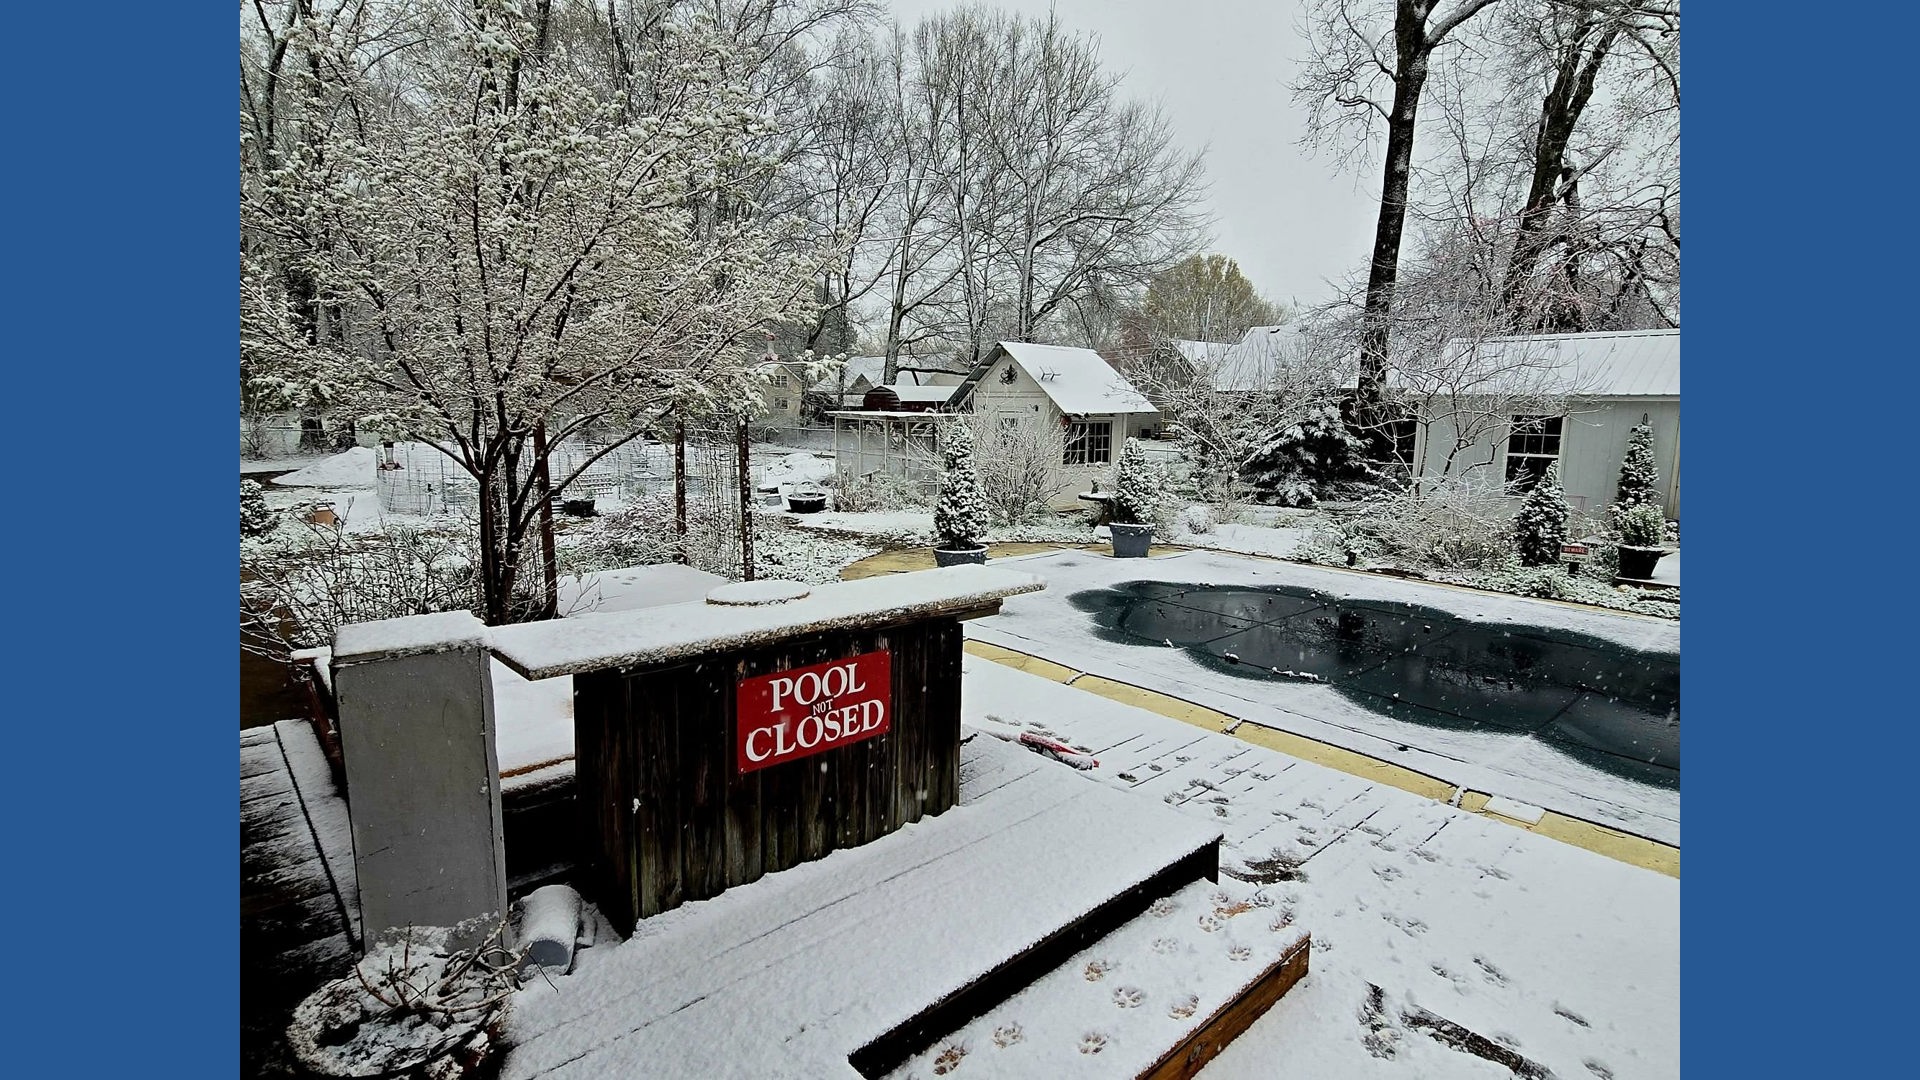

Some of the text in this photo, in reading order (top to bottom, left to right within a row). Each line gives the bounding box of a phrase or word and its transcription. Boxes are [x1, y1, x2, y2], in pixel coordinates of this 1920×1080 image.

[769, 663, 866, 712] POOL
[812, 698, 834, 716] NOT
[745, 699, 885, 762] CLOSED
